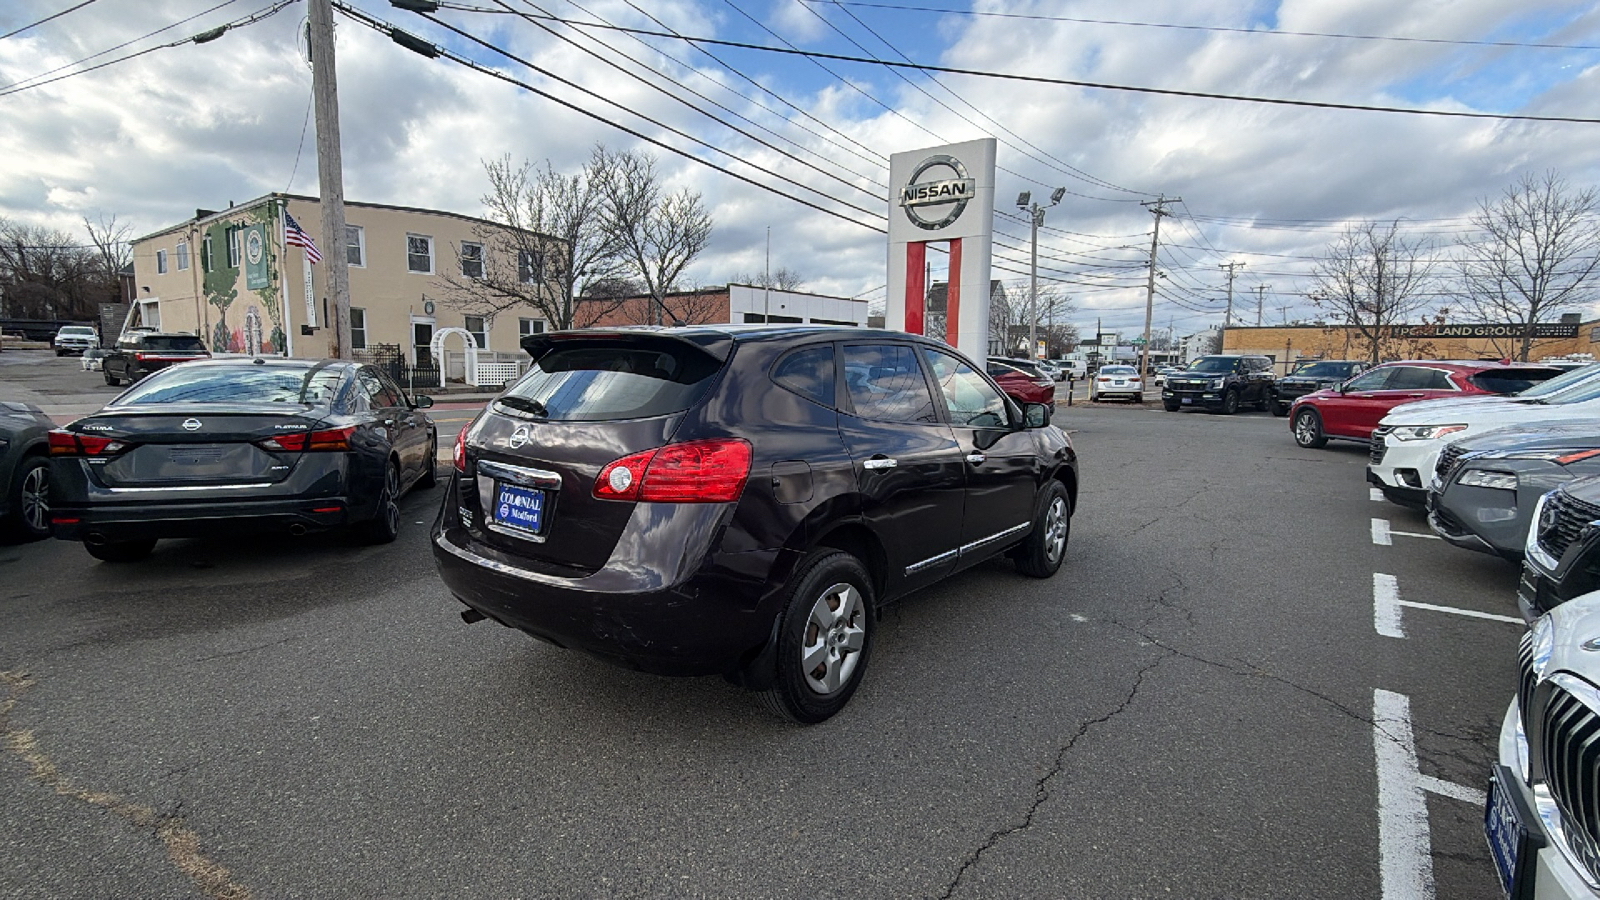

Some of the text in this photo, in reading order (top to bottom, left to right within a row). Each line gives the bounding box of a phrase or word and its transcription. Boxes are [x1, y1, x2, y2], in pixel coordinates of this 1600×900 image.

[904, 183, 966, 202] NISSAN
[500, 491, 541, 511] COLONIAL
[511, 507, 538, 523] Medford
